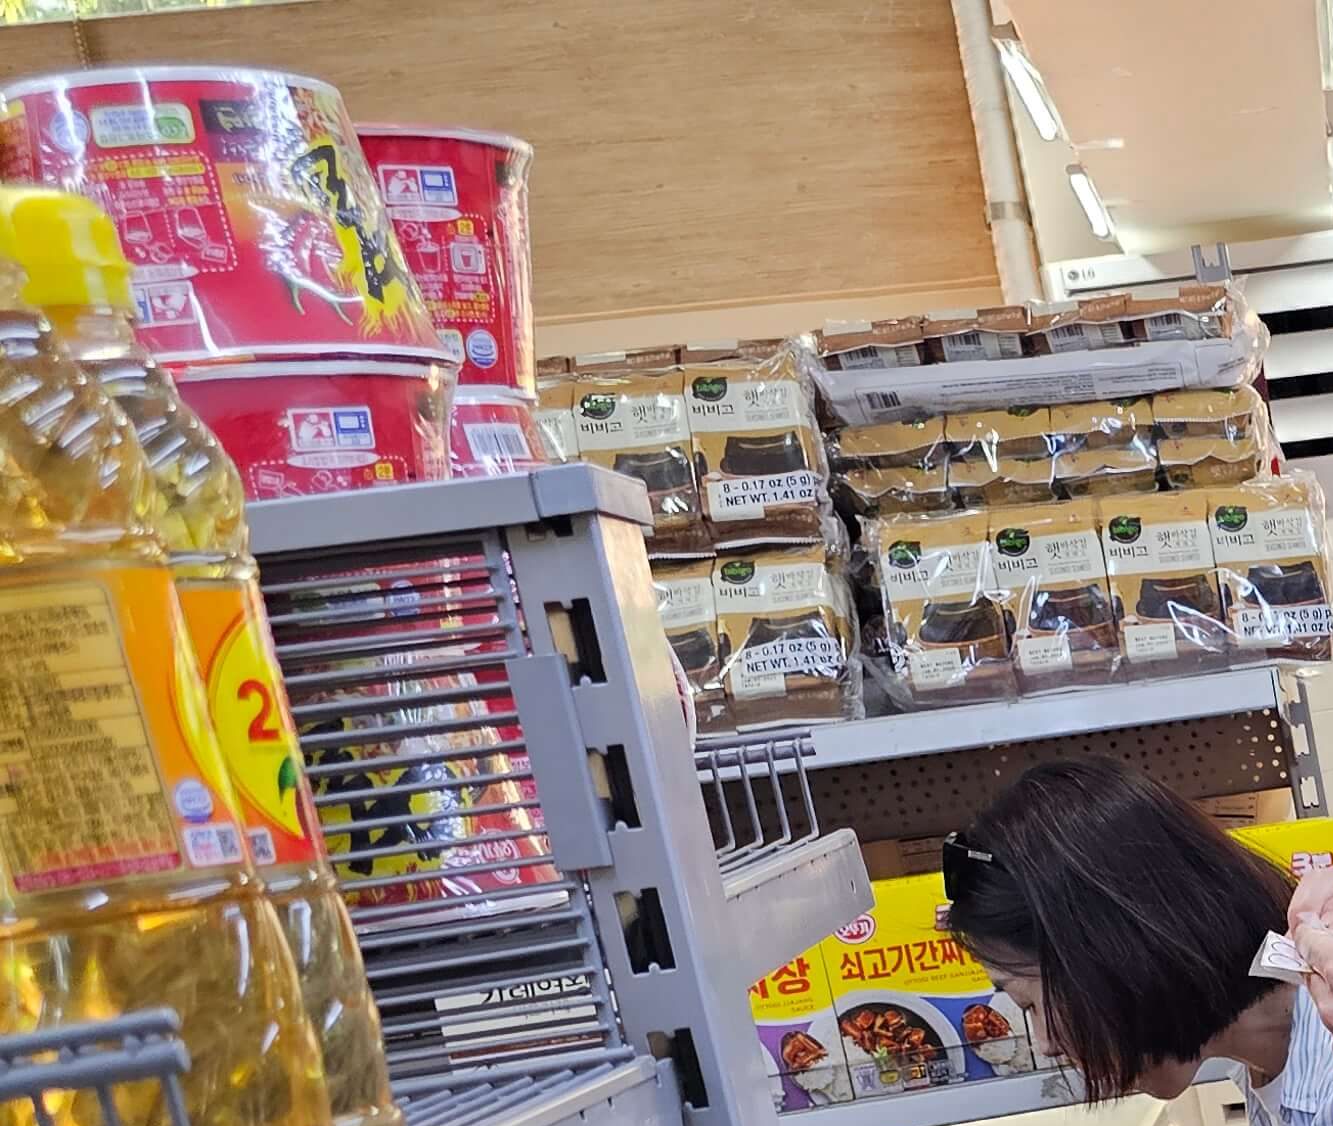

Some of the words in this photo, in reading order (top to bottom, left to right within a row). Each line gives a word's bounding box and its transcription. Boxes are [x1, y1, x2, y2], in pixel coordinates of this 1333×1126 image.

[691, 404, 735, 416] 비비고
[580, 421, 624, 433] 비비고
[741, 480, 765, 492] 0.17
[768, 480, 783, 490] oz
[785, 477, 799, 490] (5
[800, 476, 812, 488] g)
[726, 496, 748, 507] NET
[749, 492, 771, 504] WT.
[773, 489, 796, 501] 1.41
[799, 489, 814, 498] oz
[1216, 533, 1255, 546] 비비고
[1109, 545, 1149, 558] 비비고
[998, 558, 1038, 573] 비비고
[890, 570, 929, 584] 비비고
[719, 586, 761, 598] 비비고
[746, 662, 769, 674] NET
[237, 680, 280, 743] 2
